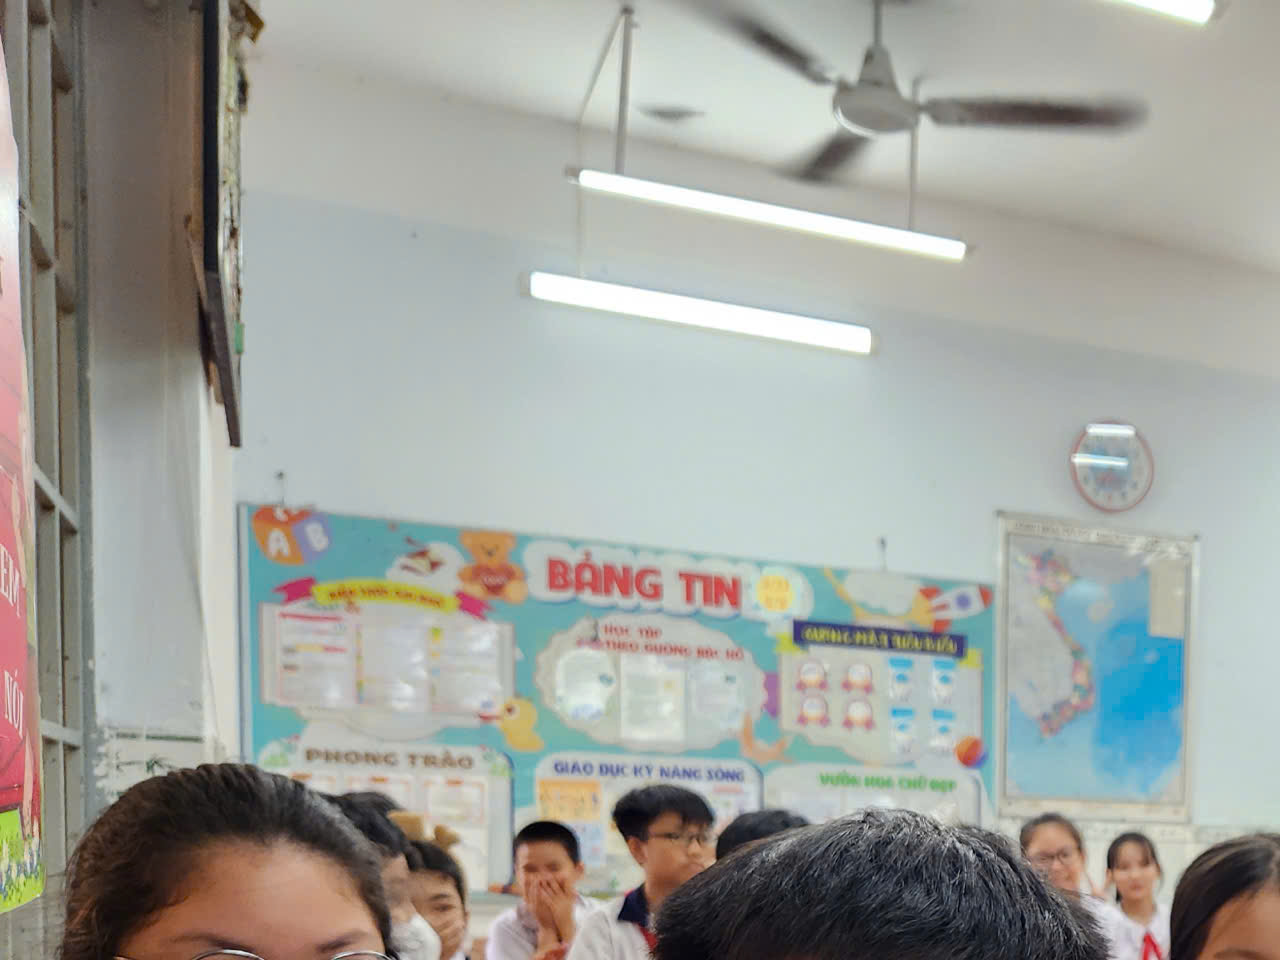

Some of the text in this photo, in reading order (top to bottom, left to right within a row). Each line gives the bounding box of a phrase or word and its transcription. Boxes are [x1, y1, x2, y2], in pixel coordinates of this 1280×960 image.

[547, 550, 742, 609] BẢNG TIN
[306, 748, 473, 770] PHONG TRÀO
